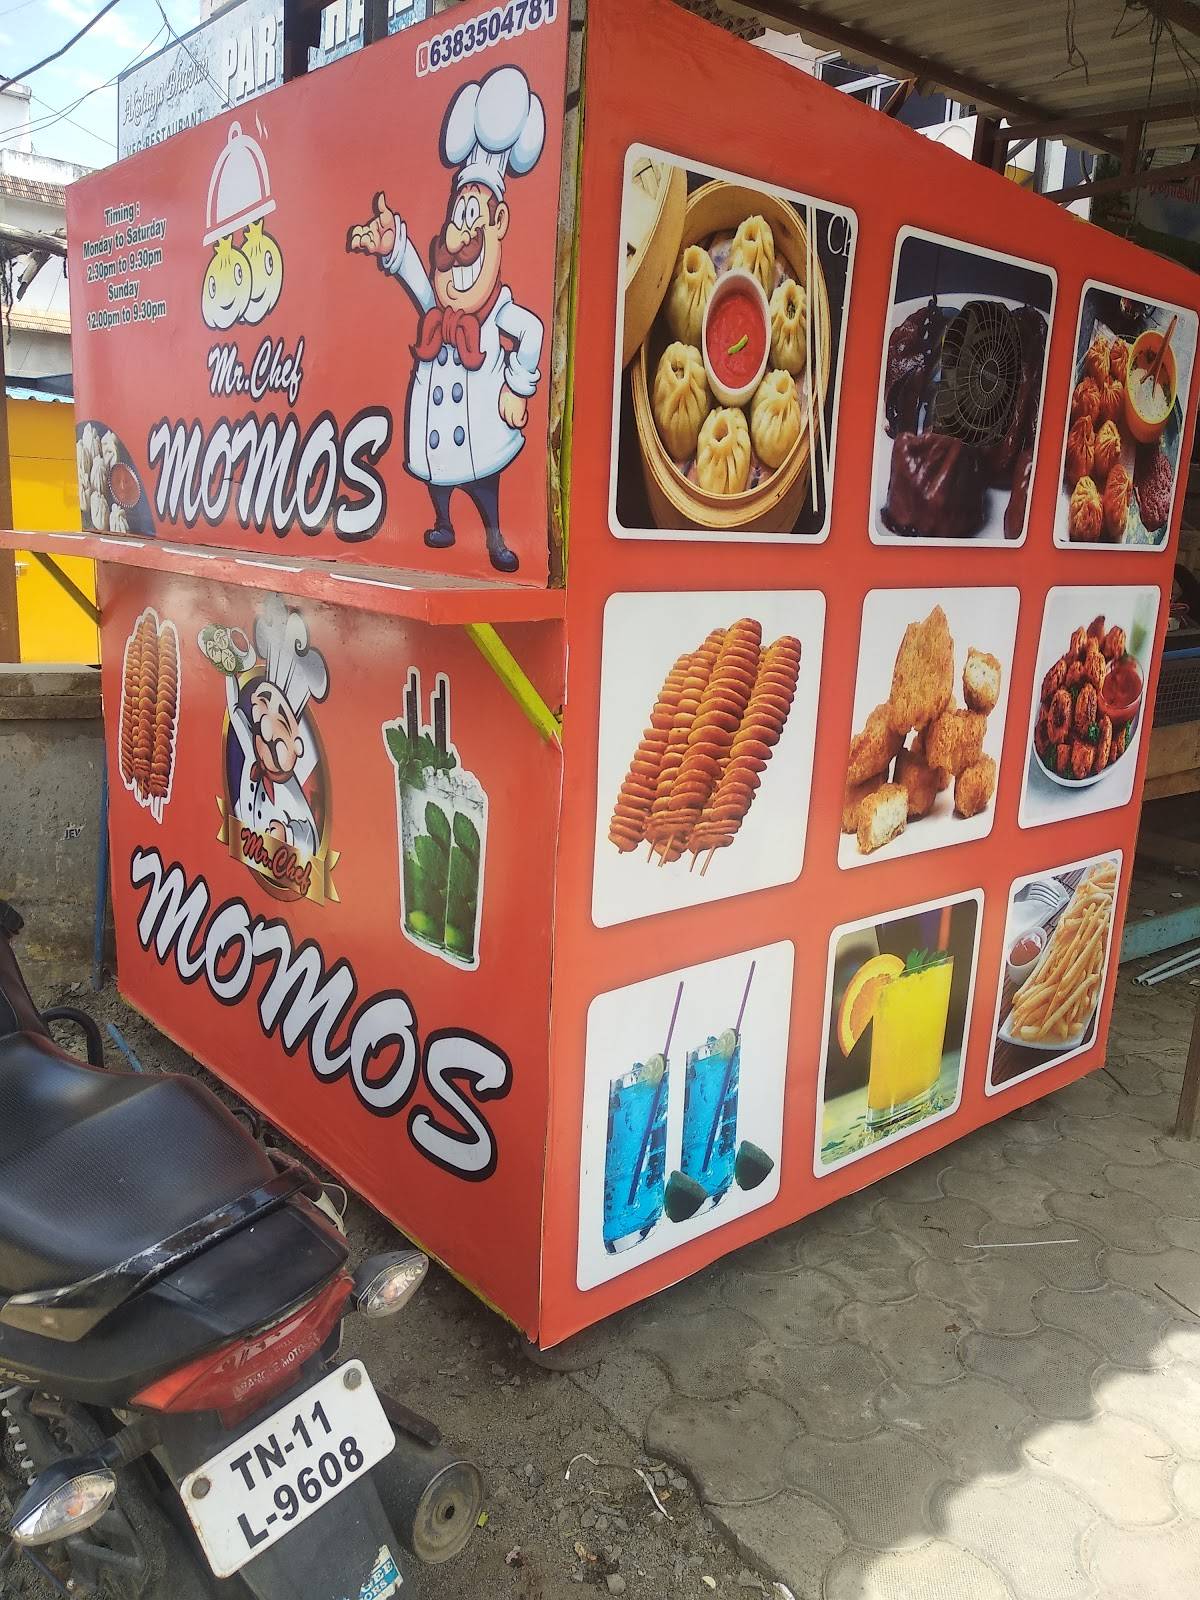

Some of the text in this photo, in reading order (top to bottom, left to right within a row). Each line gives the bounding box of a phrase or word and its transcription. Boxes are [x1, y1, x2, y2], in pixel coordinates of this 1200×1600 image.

[429, 0, 557, 67] 6383504781
[83, 218, 167, 260] Monday to Saturday
[104, 203, 134, 227] Timing
[87, 248, 163, 283] 2.30pm to 9.30pm
[108, 279, 140, 302] Sunday
[87, 300, 167, 331] 12.00pm to 9.30pm
[148, 405, 393, 543] MOMOS
[131, 846, 513, 1182] MOMOS
[229, 1400, 332, 1491] TN-11
[237, 1436, 364, 1549] L-9608
